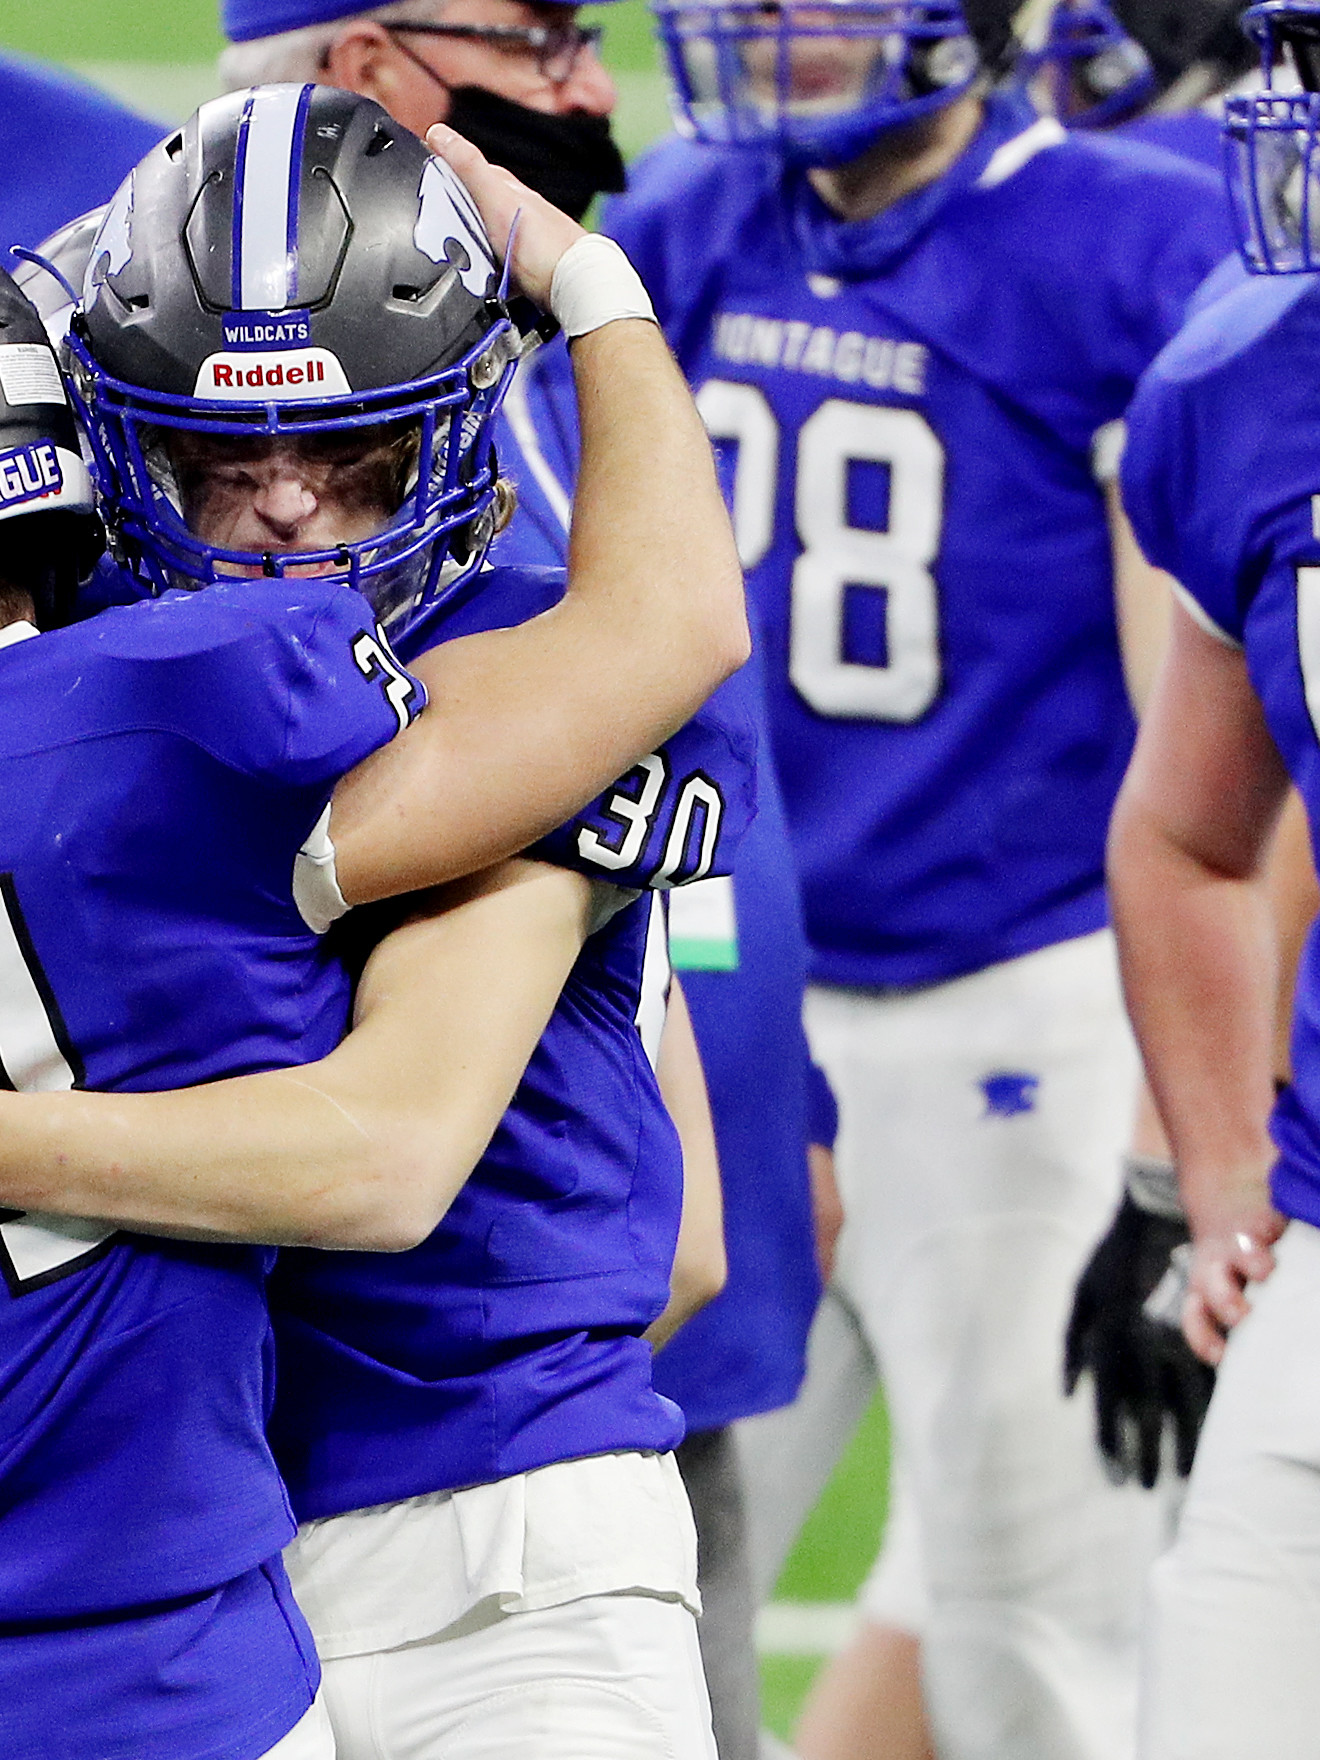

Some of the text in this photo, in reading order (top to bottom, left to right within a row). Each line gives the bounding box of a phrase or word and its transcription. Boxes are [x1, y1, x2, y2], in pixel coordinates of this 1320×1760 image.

[224, 323, 308, 343] WILDCATS
[213, 360, 324, 387] Riddell
[577, 753, 722, 889] 30
